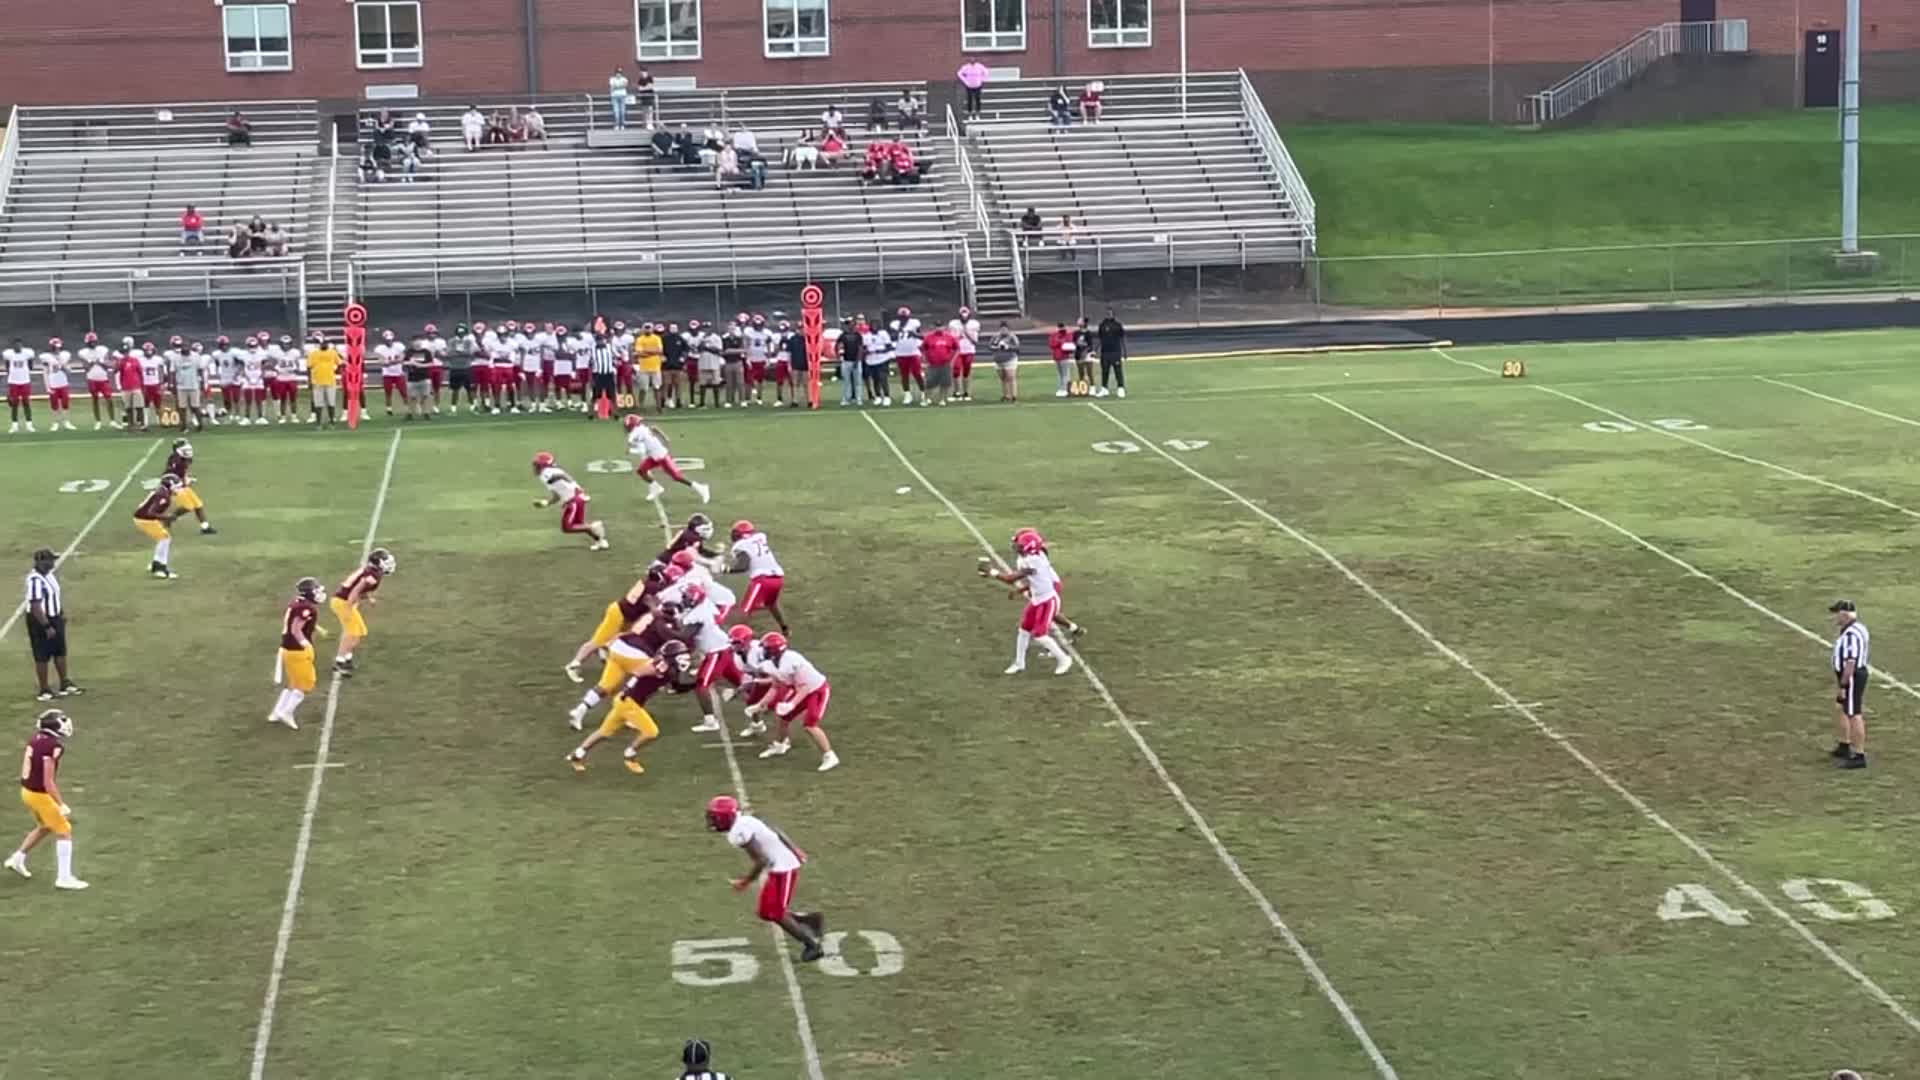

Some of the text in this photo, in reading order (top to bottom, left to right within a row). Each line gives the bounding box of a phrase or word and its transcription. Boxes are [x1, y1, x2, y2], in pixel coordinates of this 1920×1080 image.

[1503, 361, 1521, 376] 30
[616, 394, 634, 408] 50
[161, 410, 180, 426] 40
[671, 929, 905, 986] 50
